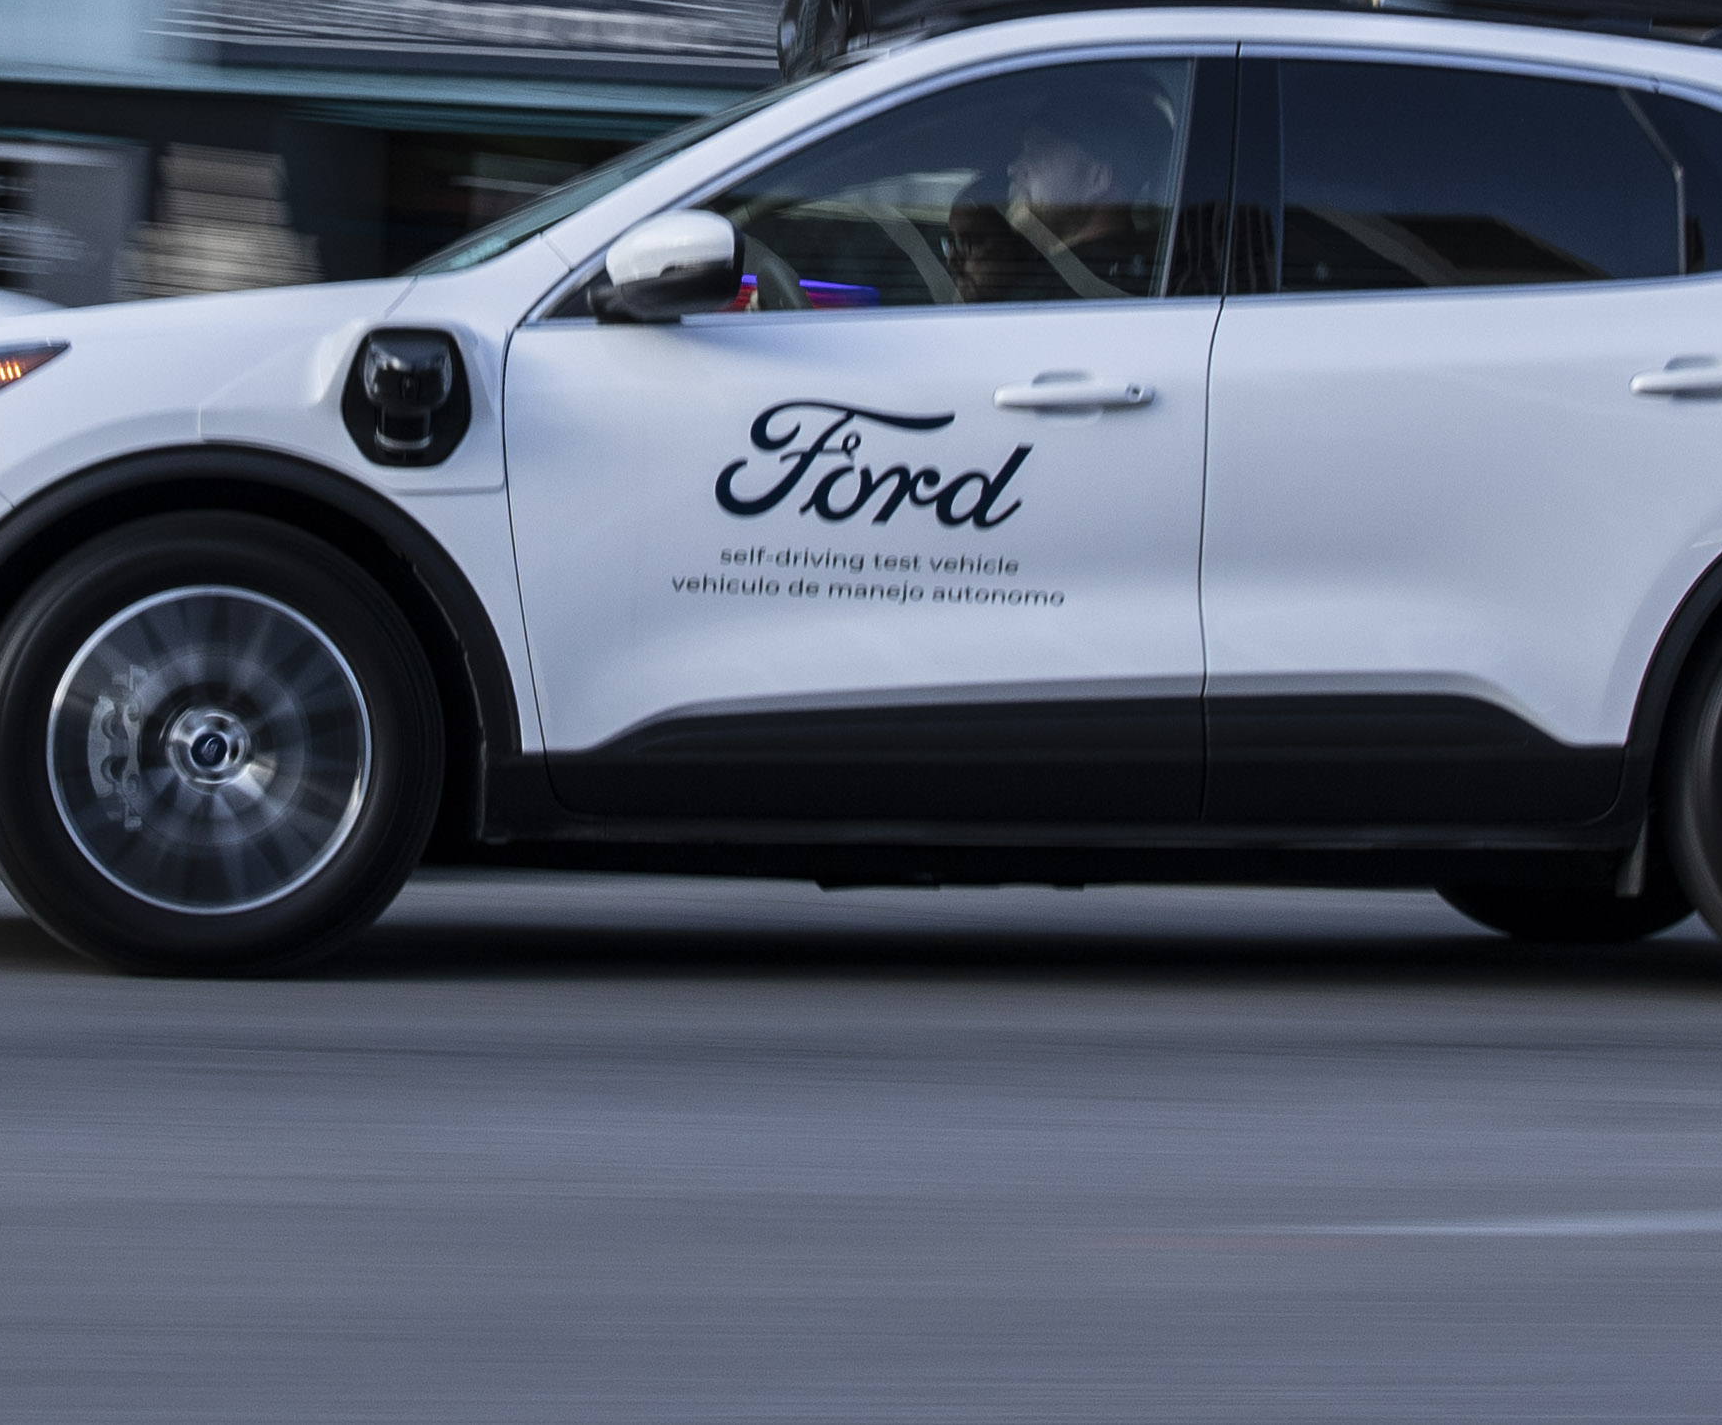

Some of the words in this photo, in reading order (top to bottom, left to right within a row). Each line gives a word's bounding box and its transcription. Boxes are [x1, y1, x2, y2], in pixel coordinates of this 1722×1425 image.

[715, 397, 1034, 530] Ford
[719, 546, 865, 573] self-driving
[873, 551, 922, 572] test
[929, 551, 1020, 577] vehicle
[671, 572, 780, 597] vehiculo
[788, 577, 820, 599] de
[827, 580, 925, 606] manejo
[932, 584, 1066, 608] autonomo
